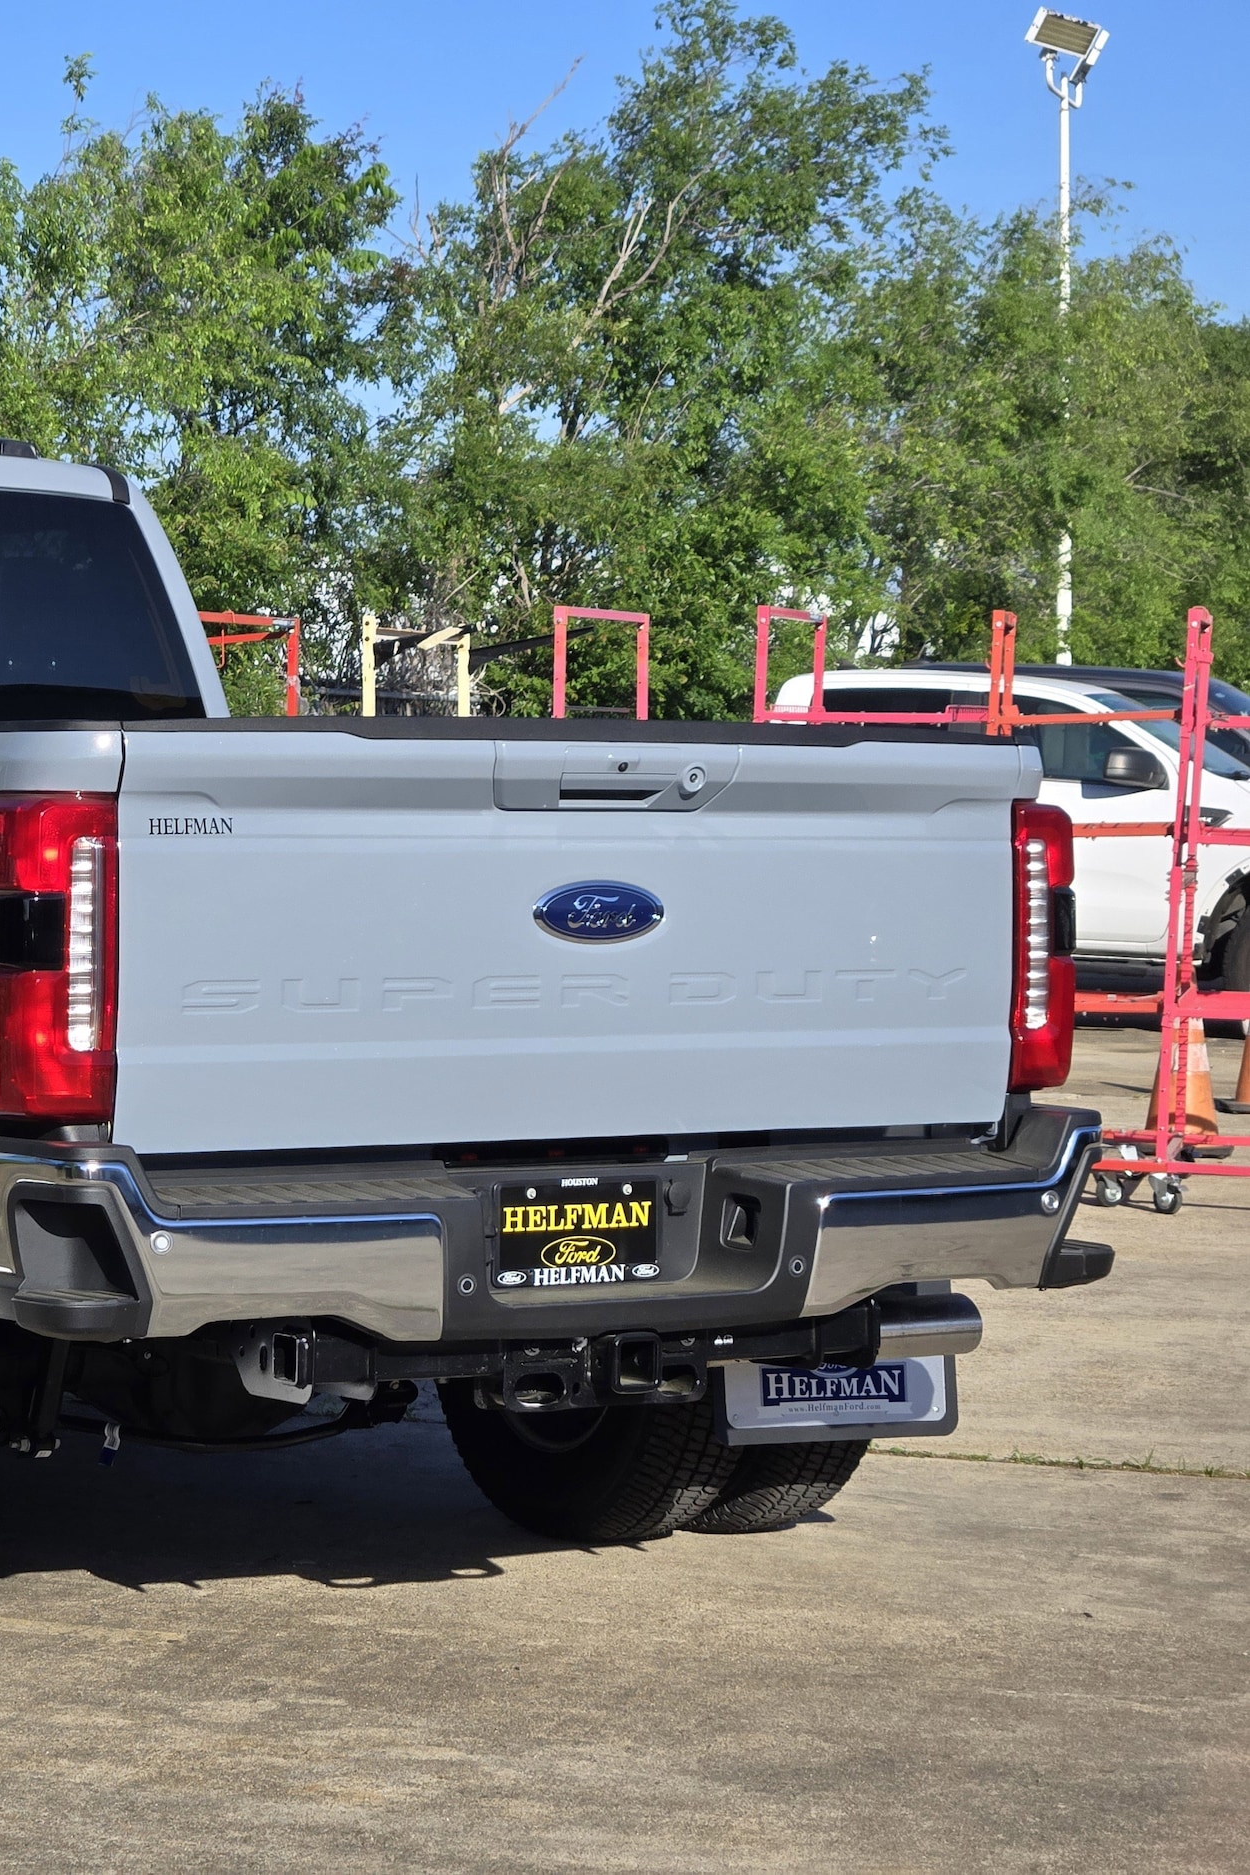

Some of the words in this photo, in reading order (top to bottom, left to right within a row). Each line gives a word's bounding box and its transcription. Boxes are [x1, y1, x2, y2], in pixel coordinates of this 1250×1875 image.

[149, 817, 233, 835] HELFMAN
[567, 894, 636, 928] Ford
[182, 974, 629, 1015] SUPER
[669, 968, 967, 1005] DUTY
[561, 1177, 598, 1187] HOUSTON
[502, 1201, 652, 1232] HELFMAN
[554, 1240, 601, 1264] Ford
[533, 1264, 625, 1286] HELFMAN
[766, 1370, 901, 1399] HELFMAN
[788, 1402, 881, 1413] www.HelfmanFord.com
